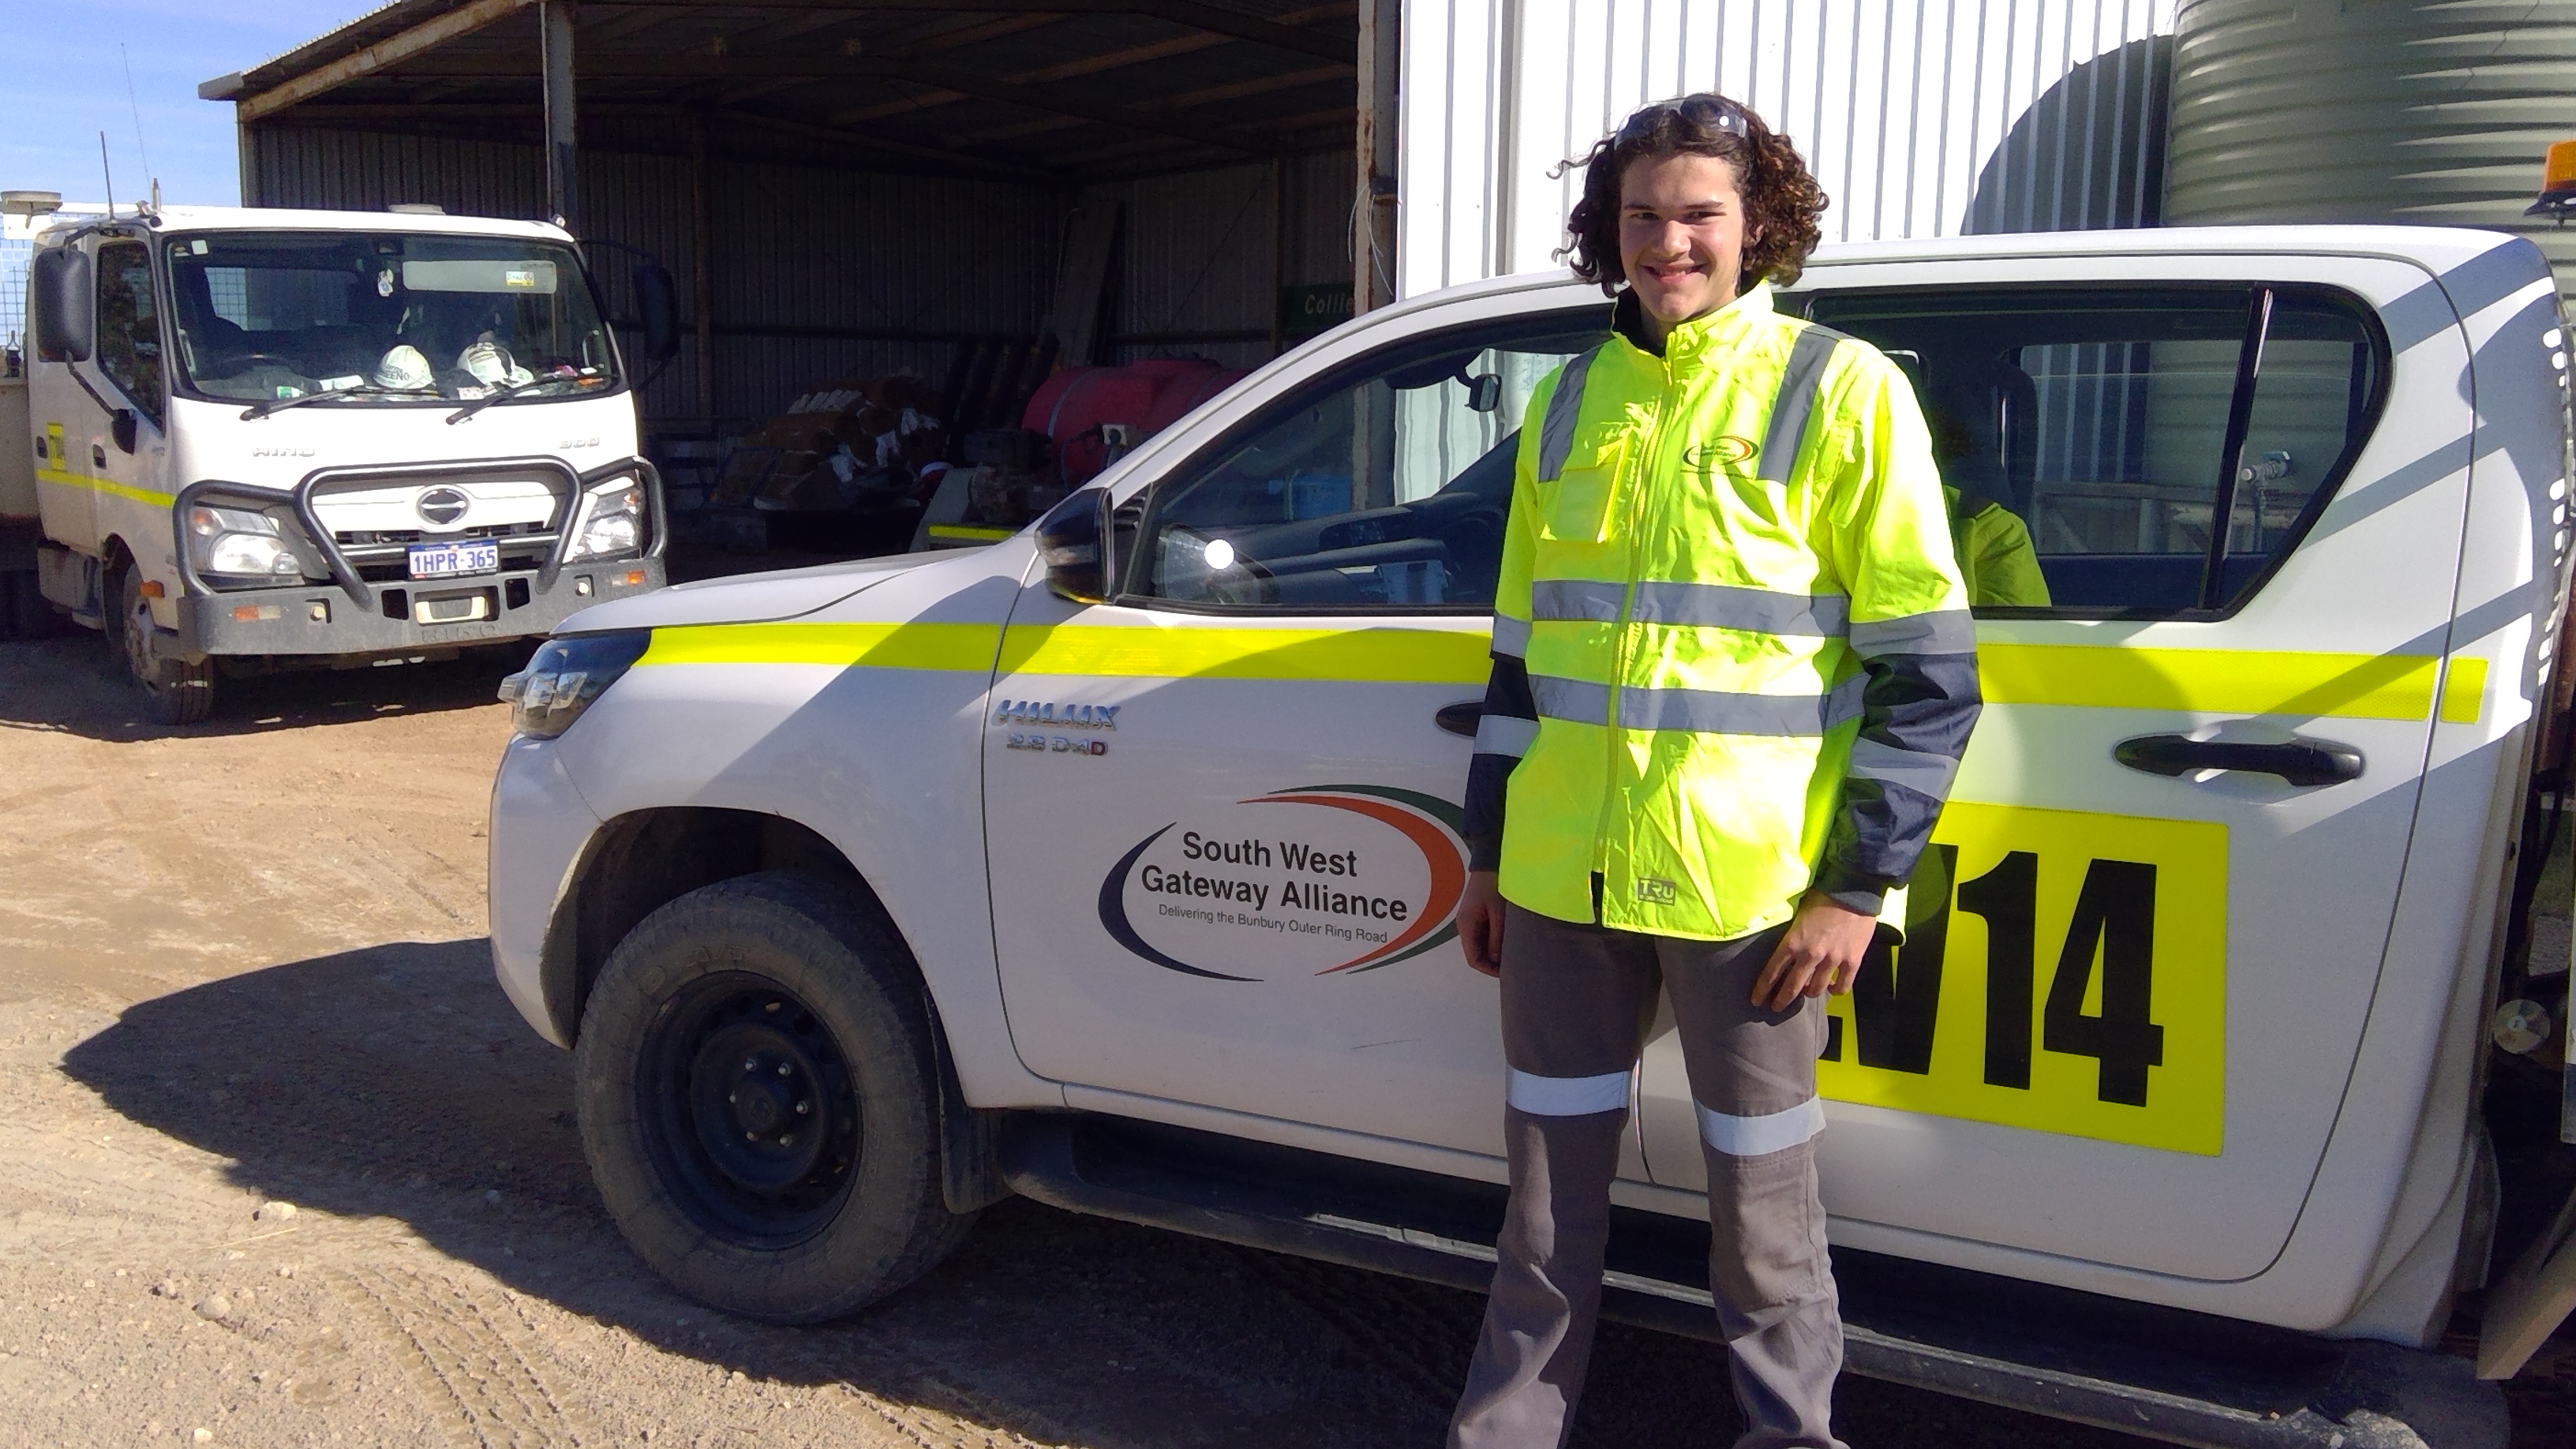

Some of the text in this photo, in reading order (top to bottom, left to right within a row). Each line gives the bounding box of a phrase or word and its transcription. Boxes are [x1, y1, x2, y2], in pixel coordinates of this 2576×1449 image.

[253, 447, 315, 457] HINO
[998, 699, 1121, 731] HILUX
[1183, 831, 1357, 877] South West
[1141, 864, 1407, 922] Gateway Alliance
[1640, 879, 1675, 899] TRU
[1159, 904, 1387, 943] Delivering the Bunbury Outer Ring Road
[1818, 843, 2163, 1107] V14
